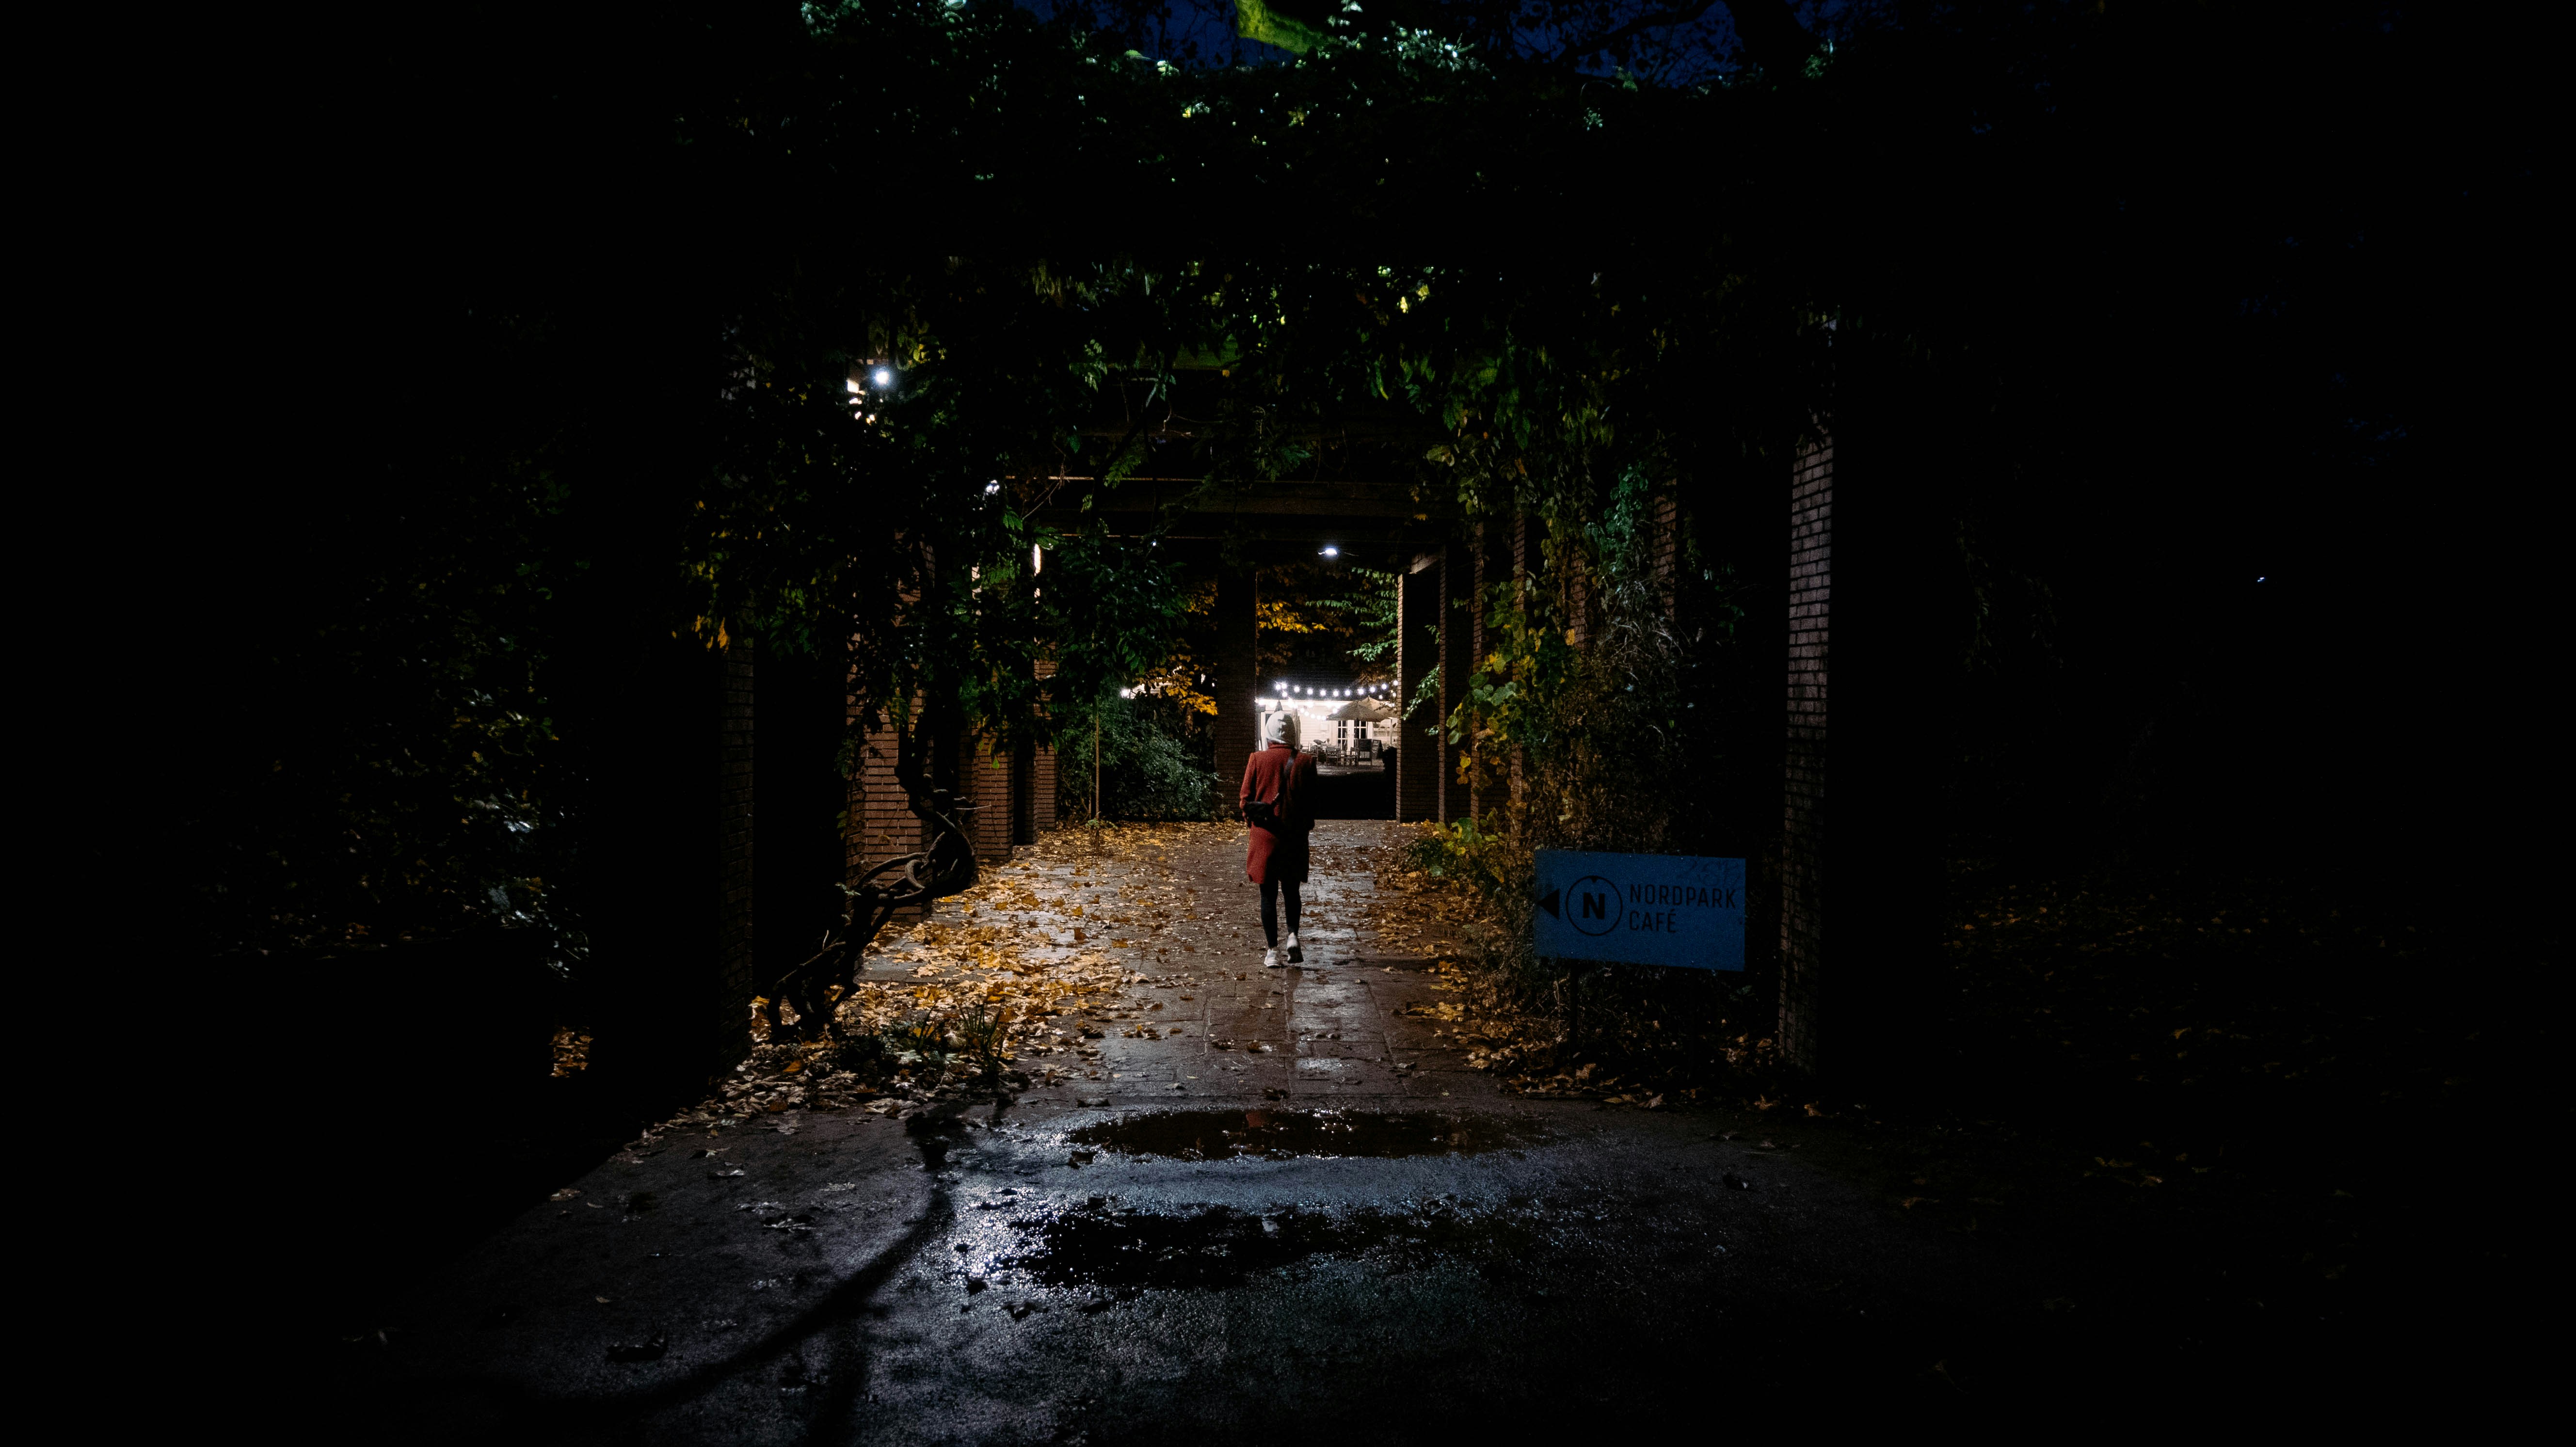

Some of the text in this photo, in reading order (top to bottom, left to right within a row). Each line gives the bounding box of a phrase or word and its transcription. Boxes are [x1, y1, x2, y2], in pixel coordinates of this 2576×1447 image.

[1583, 892, 1605, 919] N
[1630, 884, 1737, 908] NORDPARK
[1629, 909, 1676, 933] CAFÉ
